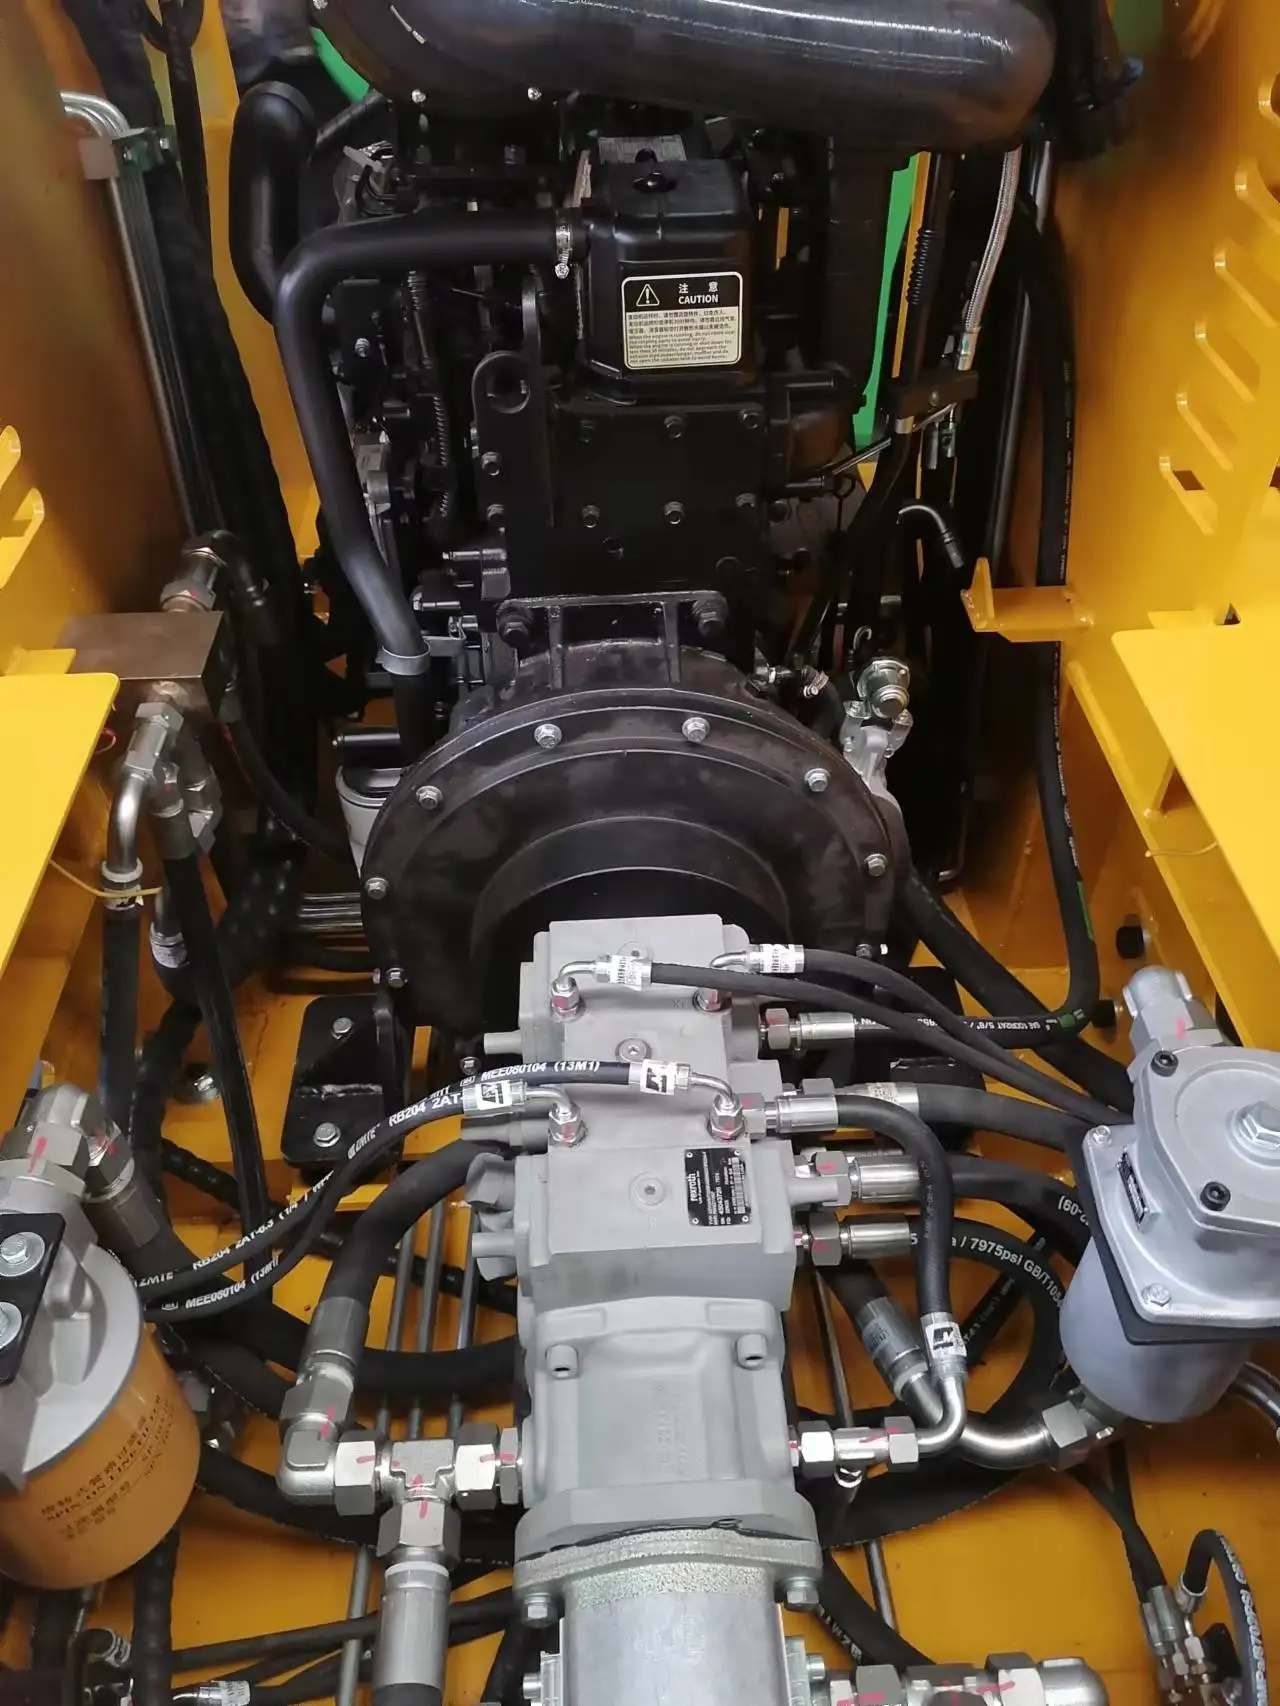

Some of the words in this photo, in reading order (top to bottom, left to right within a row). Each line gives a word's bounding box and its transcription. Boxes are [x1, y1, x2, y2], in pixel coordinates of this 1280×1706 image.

[678, 294, 718, 304] CAUTION
[388, 1102, 426, 1128] RB204
[431, 1092, 464, 1110] 2AT-
[687, 1173, 698, 1202] rexroth
[970, 1237, 1023, 1266] 7975psi
[1023, 1259, 1062, 1307] GB/T105
